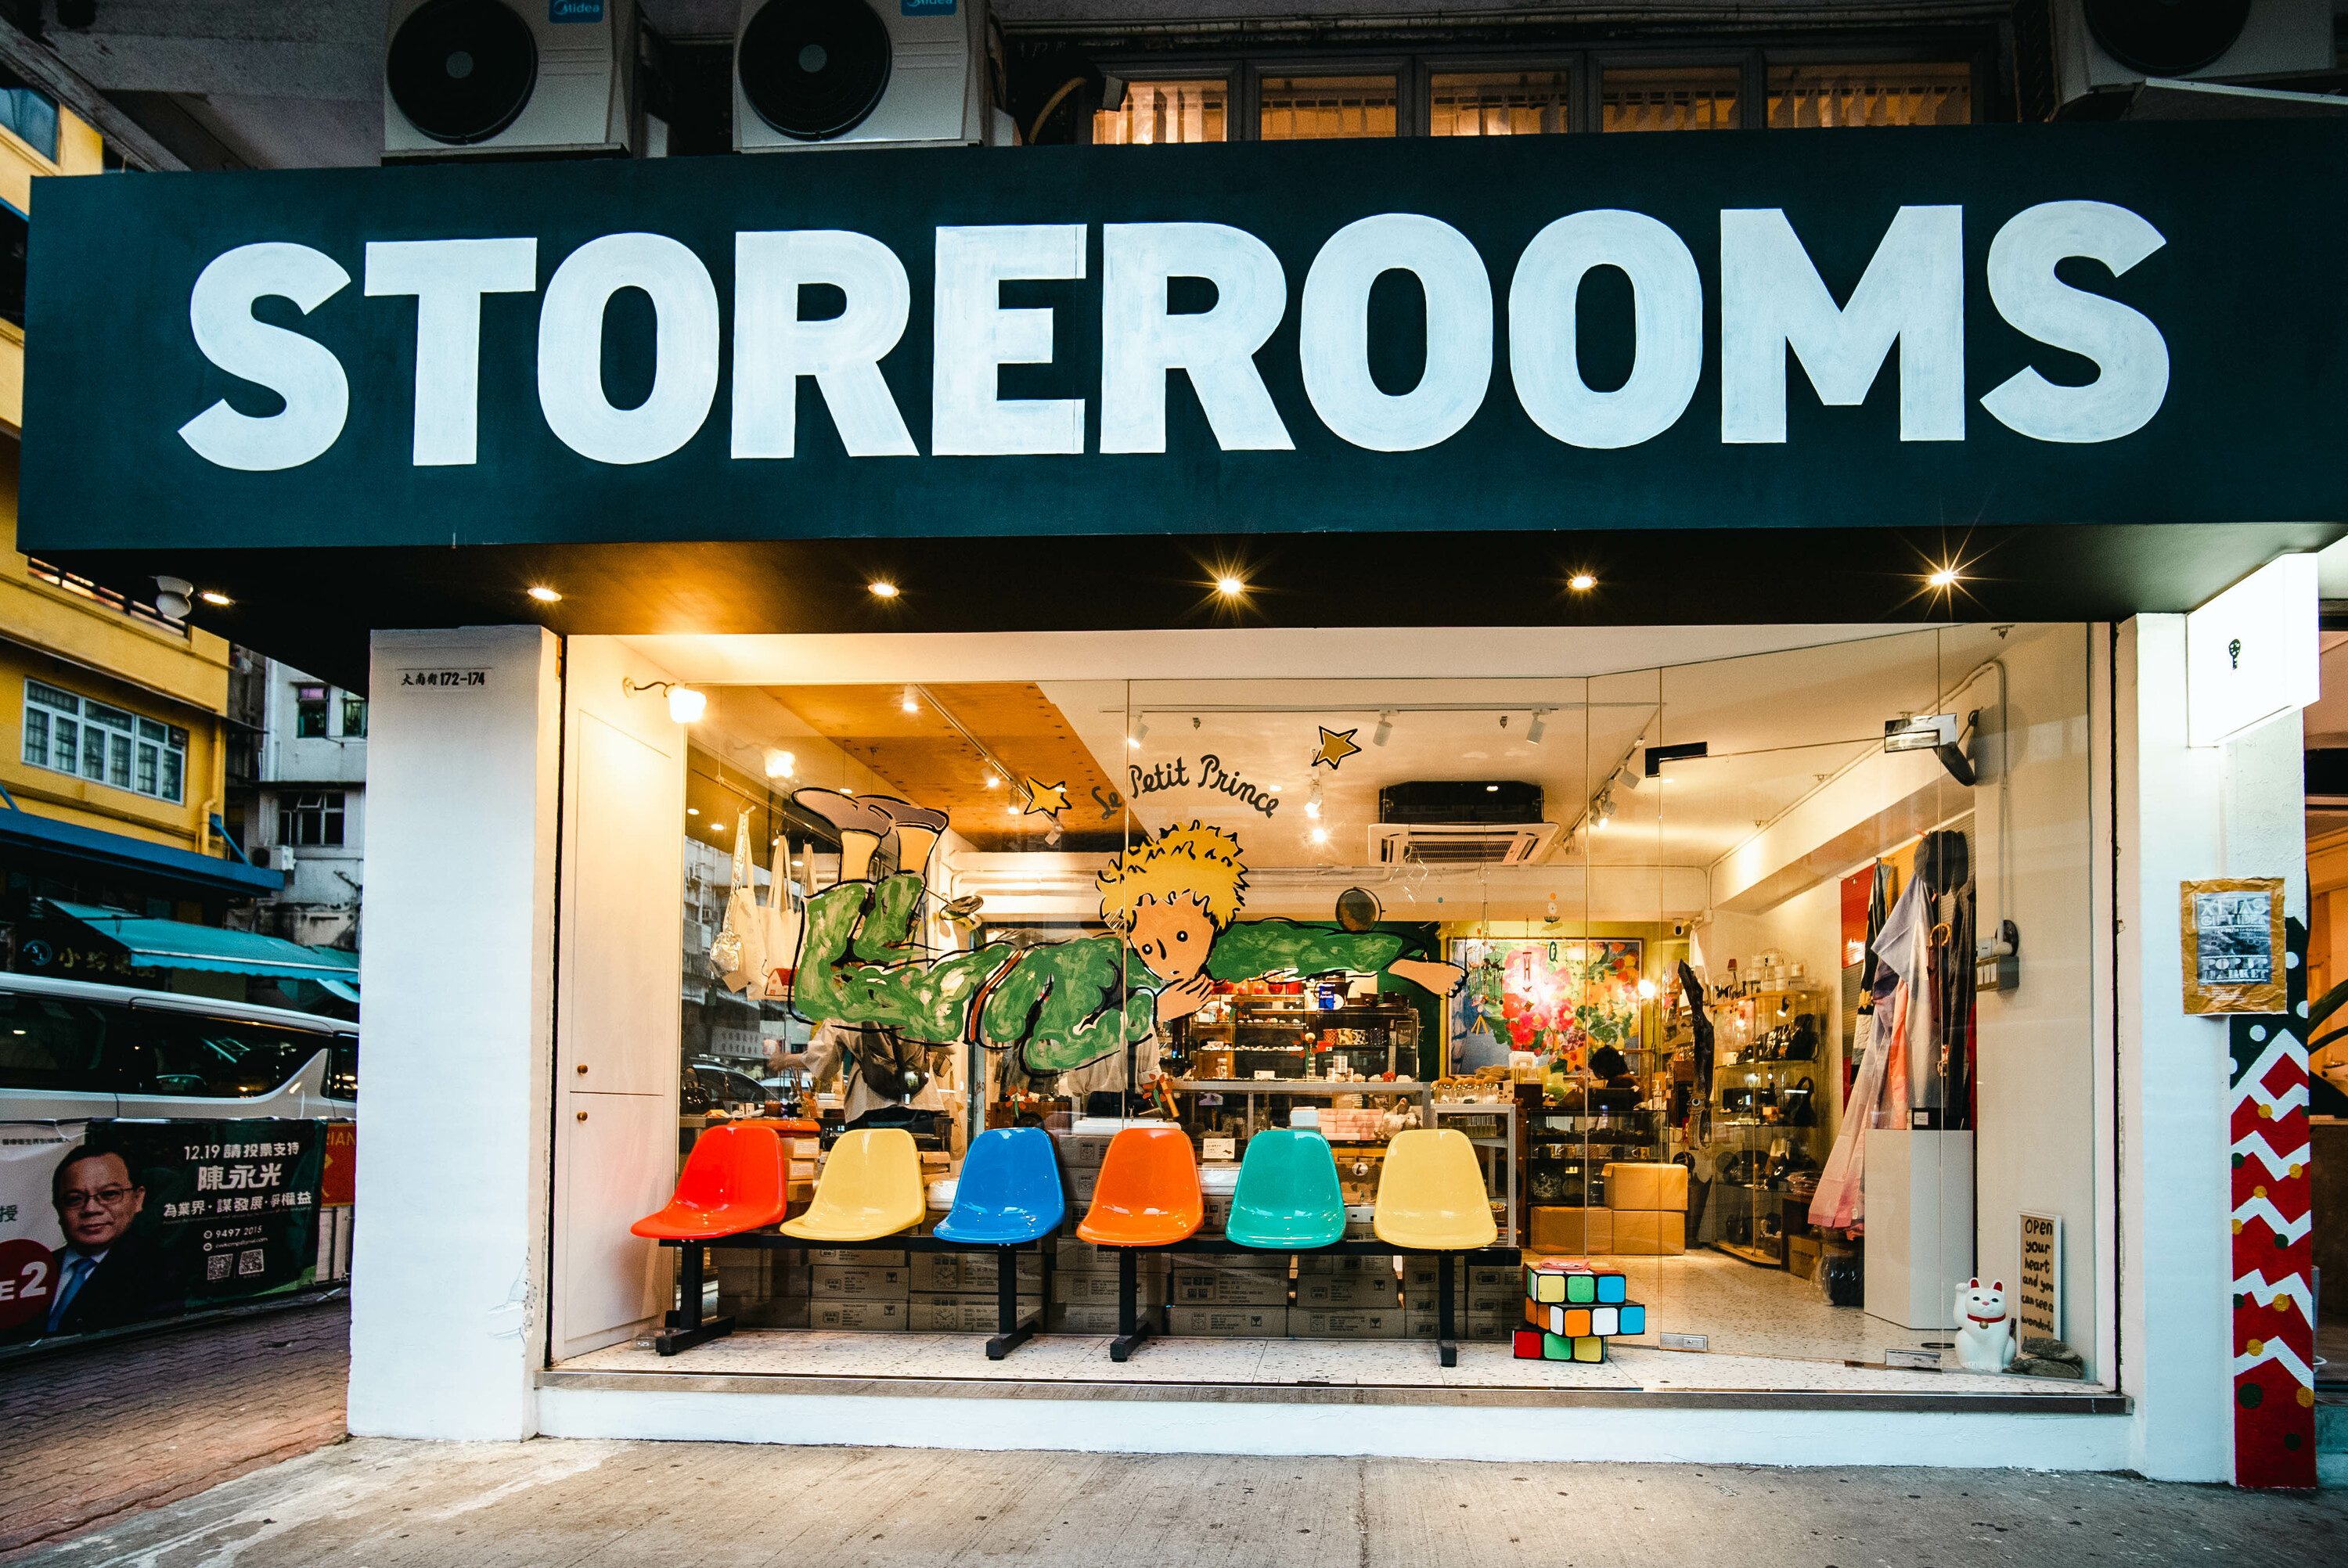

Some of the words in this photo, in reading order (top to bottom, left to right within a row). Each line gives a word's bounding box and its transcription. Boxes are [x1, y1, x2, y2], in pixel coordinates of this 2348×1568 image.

[554, 1, 600, 15] Midea
[178, 200, 2171, 472] STOREROOMS
[1092, 786, 1122, 820] Le
[1129, 756, 1190, 799] Petit
[1197, 754, 1279, 818] Prince
[2201, 915, 2235, 926] GIFT
[2201, 958, 2241, 970] POP
[2243, 957, 2268, 969] UP
[2202, 969, 2269, 980] MARKET
[184, 1144, 220, 1160] 12.19
[223, 1141, 300, 1159] 請投票支持
[197, 1163, 283, 1192] 陳永光
[215, 1228, 241, 1239] 9497
[243, 1225, 263, 1236] 2015
[2026, 1240, 2051, 1254] your
[2025, 1257, 2051, 1274] heart
[2022, 1273, 2038, 1288] and
[2040, 1280, 2054, 1293] you
[2021, 1295, 2034, 1304] can
[2035, 1298, 2047, 1311] see
[2048, 1303, 2054, 1313] a
